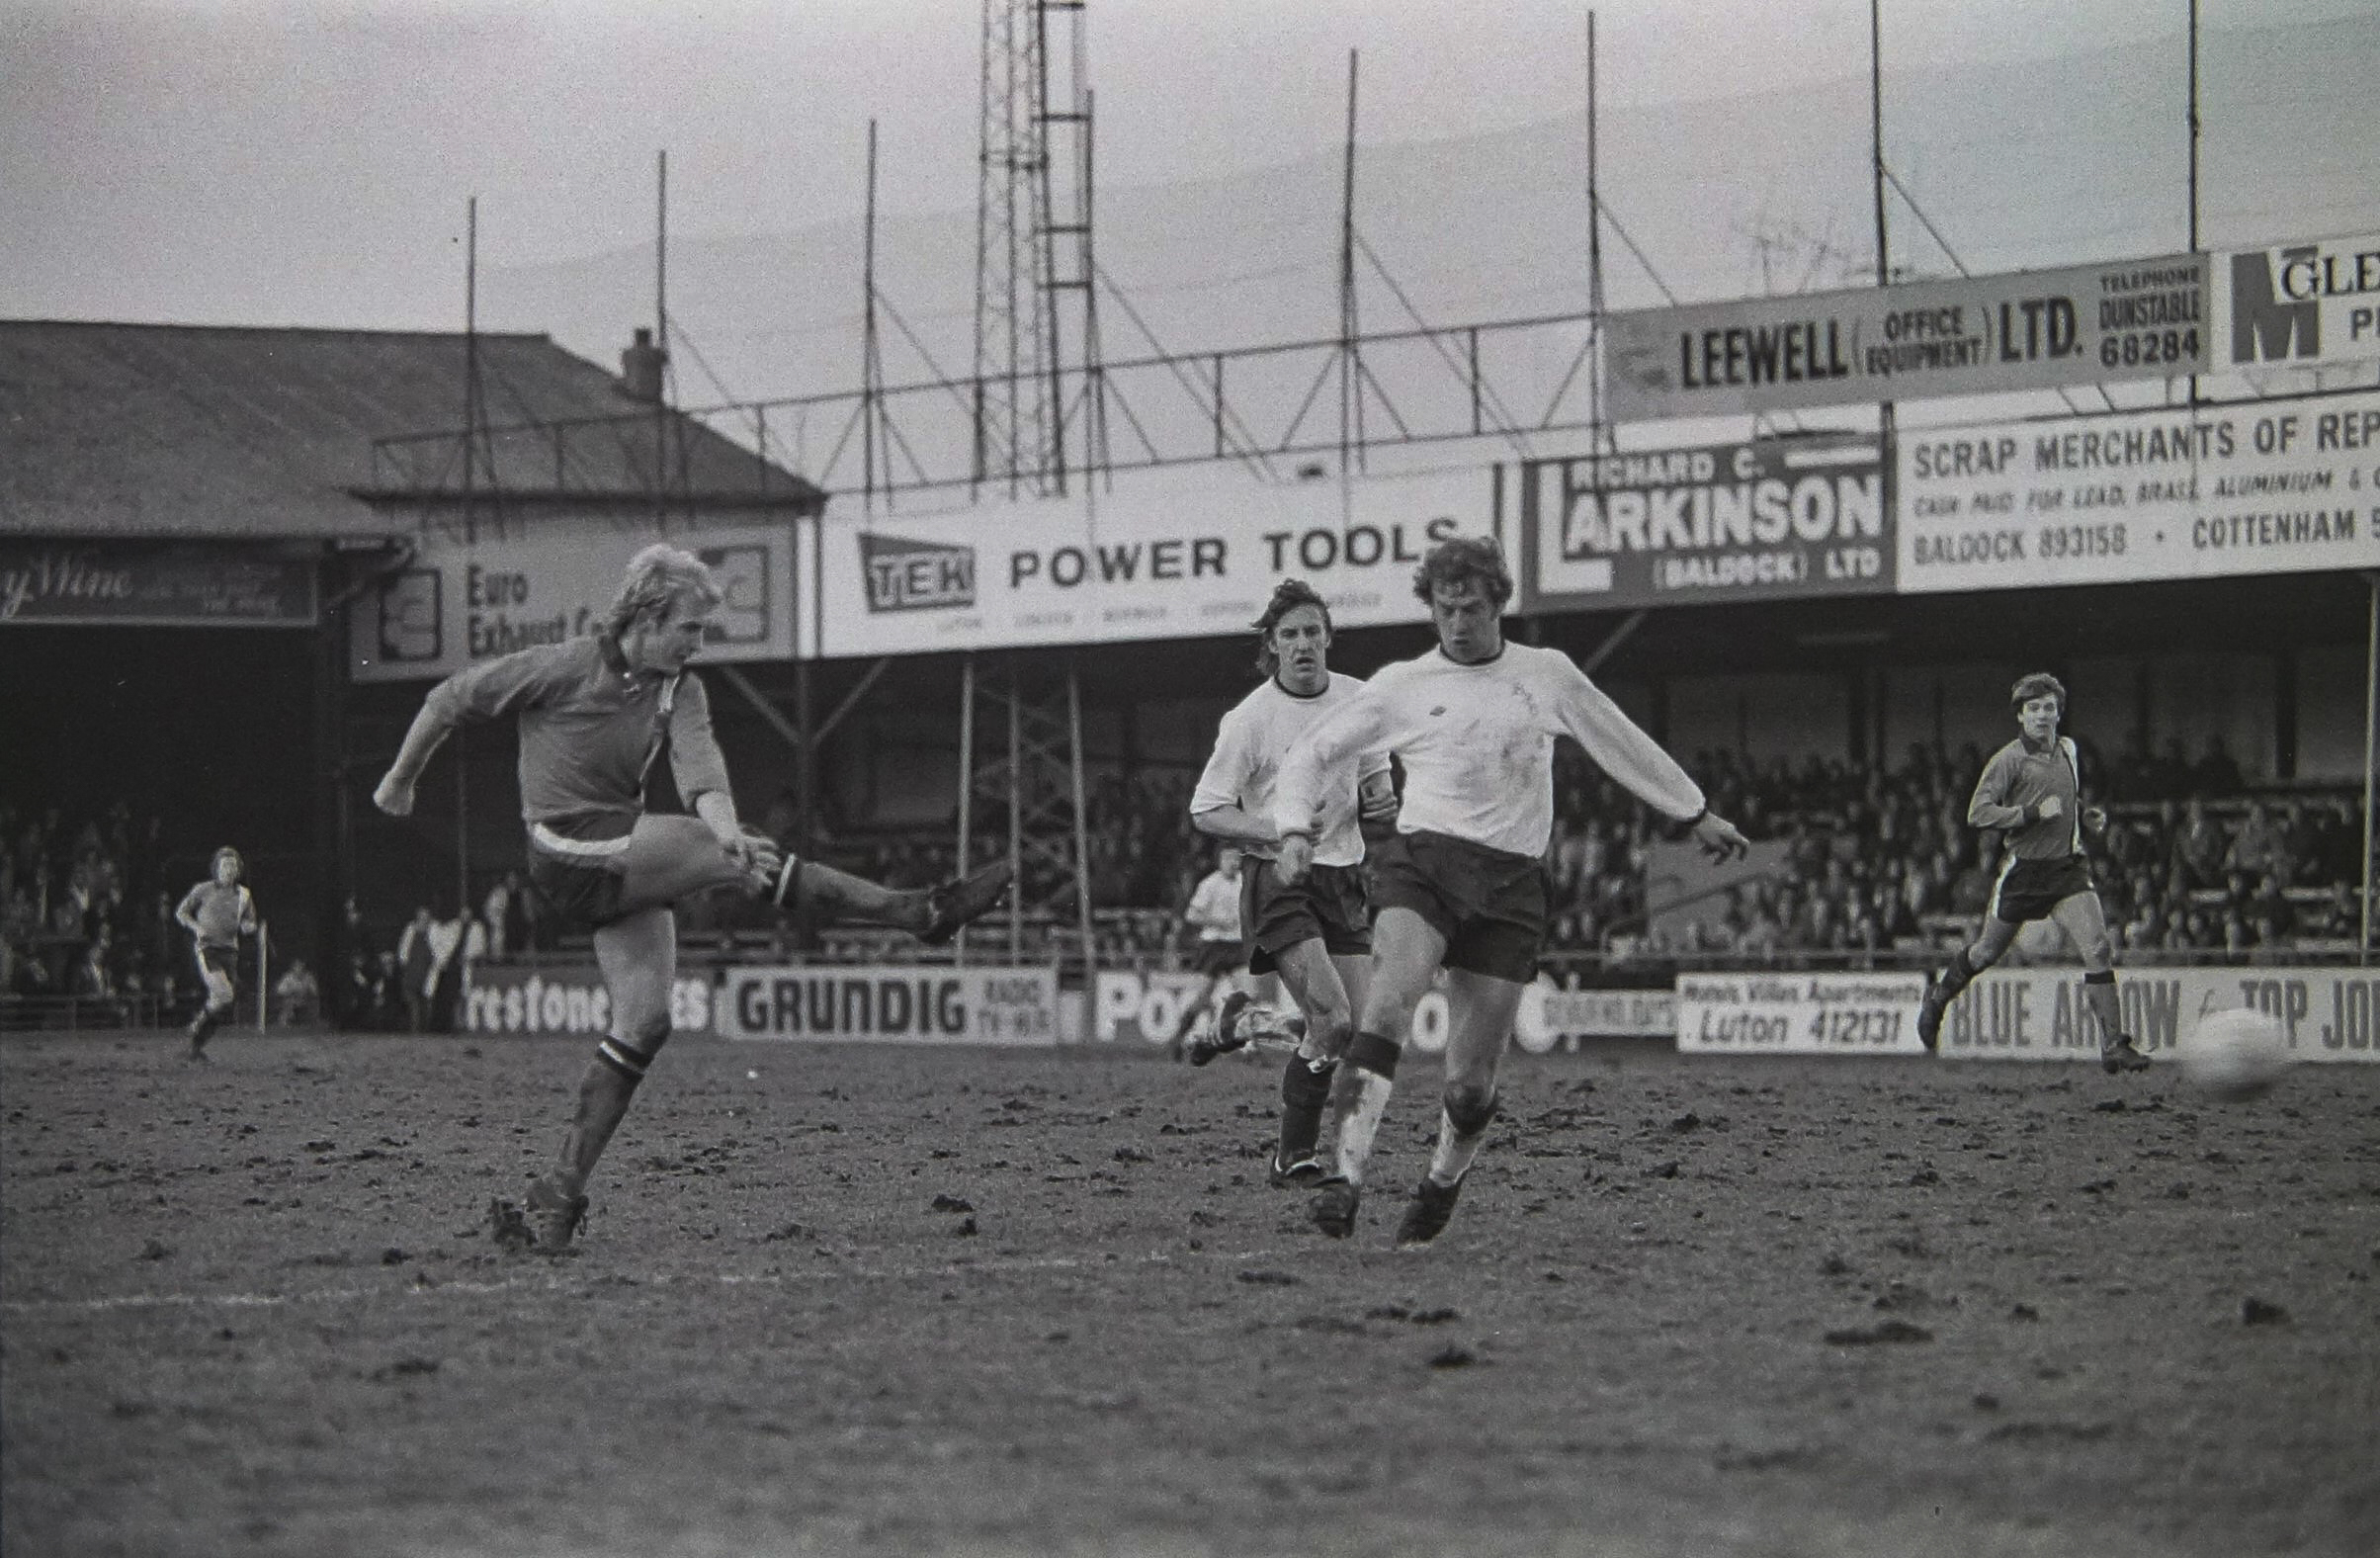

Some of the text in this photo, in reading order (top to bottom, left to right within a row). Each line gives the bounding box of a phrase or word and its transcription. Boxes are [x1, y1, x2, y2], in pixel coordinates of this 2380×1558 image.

[2099, 265, 2200, 292] TELEPHONE
[1999, 297, 2083, 363] LTD.
[2099, 289, 2200, 330] DUNSTABLE
[2351, 307, 2380, 341] P
[1682, 317, 1848, 389] LEEWELL
[2100, 328, 2200, 369] 68284
[1914, 437, 2018, 479] SCRAP
[2034, 421, 2236, 472] MERCHANTS
[2254, 416, 2298, 456] OF
[1010, 516, 1459, 589] POWER TOOLS
[1913, 530, 2027, 565] BALDOCK
[2192, 508, 2355, 549] COTTENHAM
[1826, 547, 1881, 579] LTD
[1700, 1008, 1789, 1044] Luton
[1951, 980, 2031, 1046] BLUE
[2052, 980, 2181, 1048] AROW
